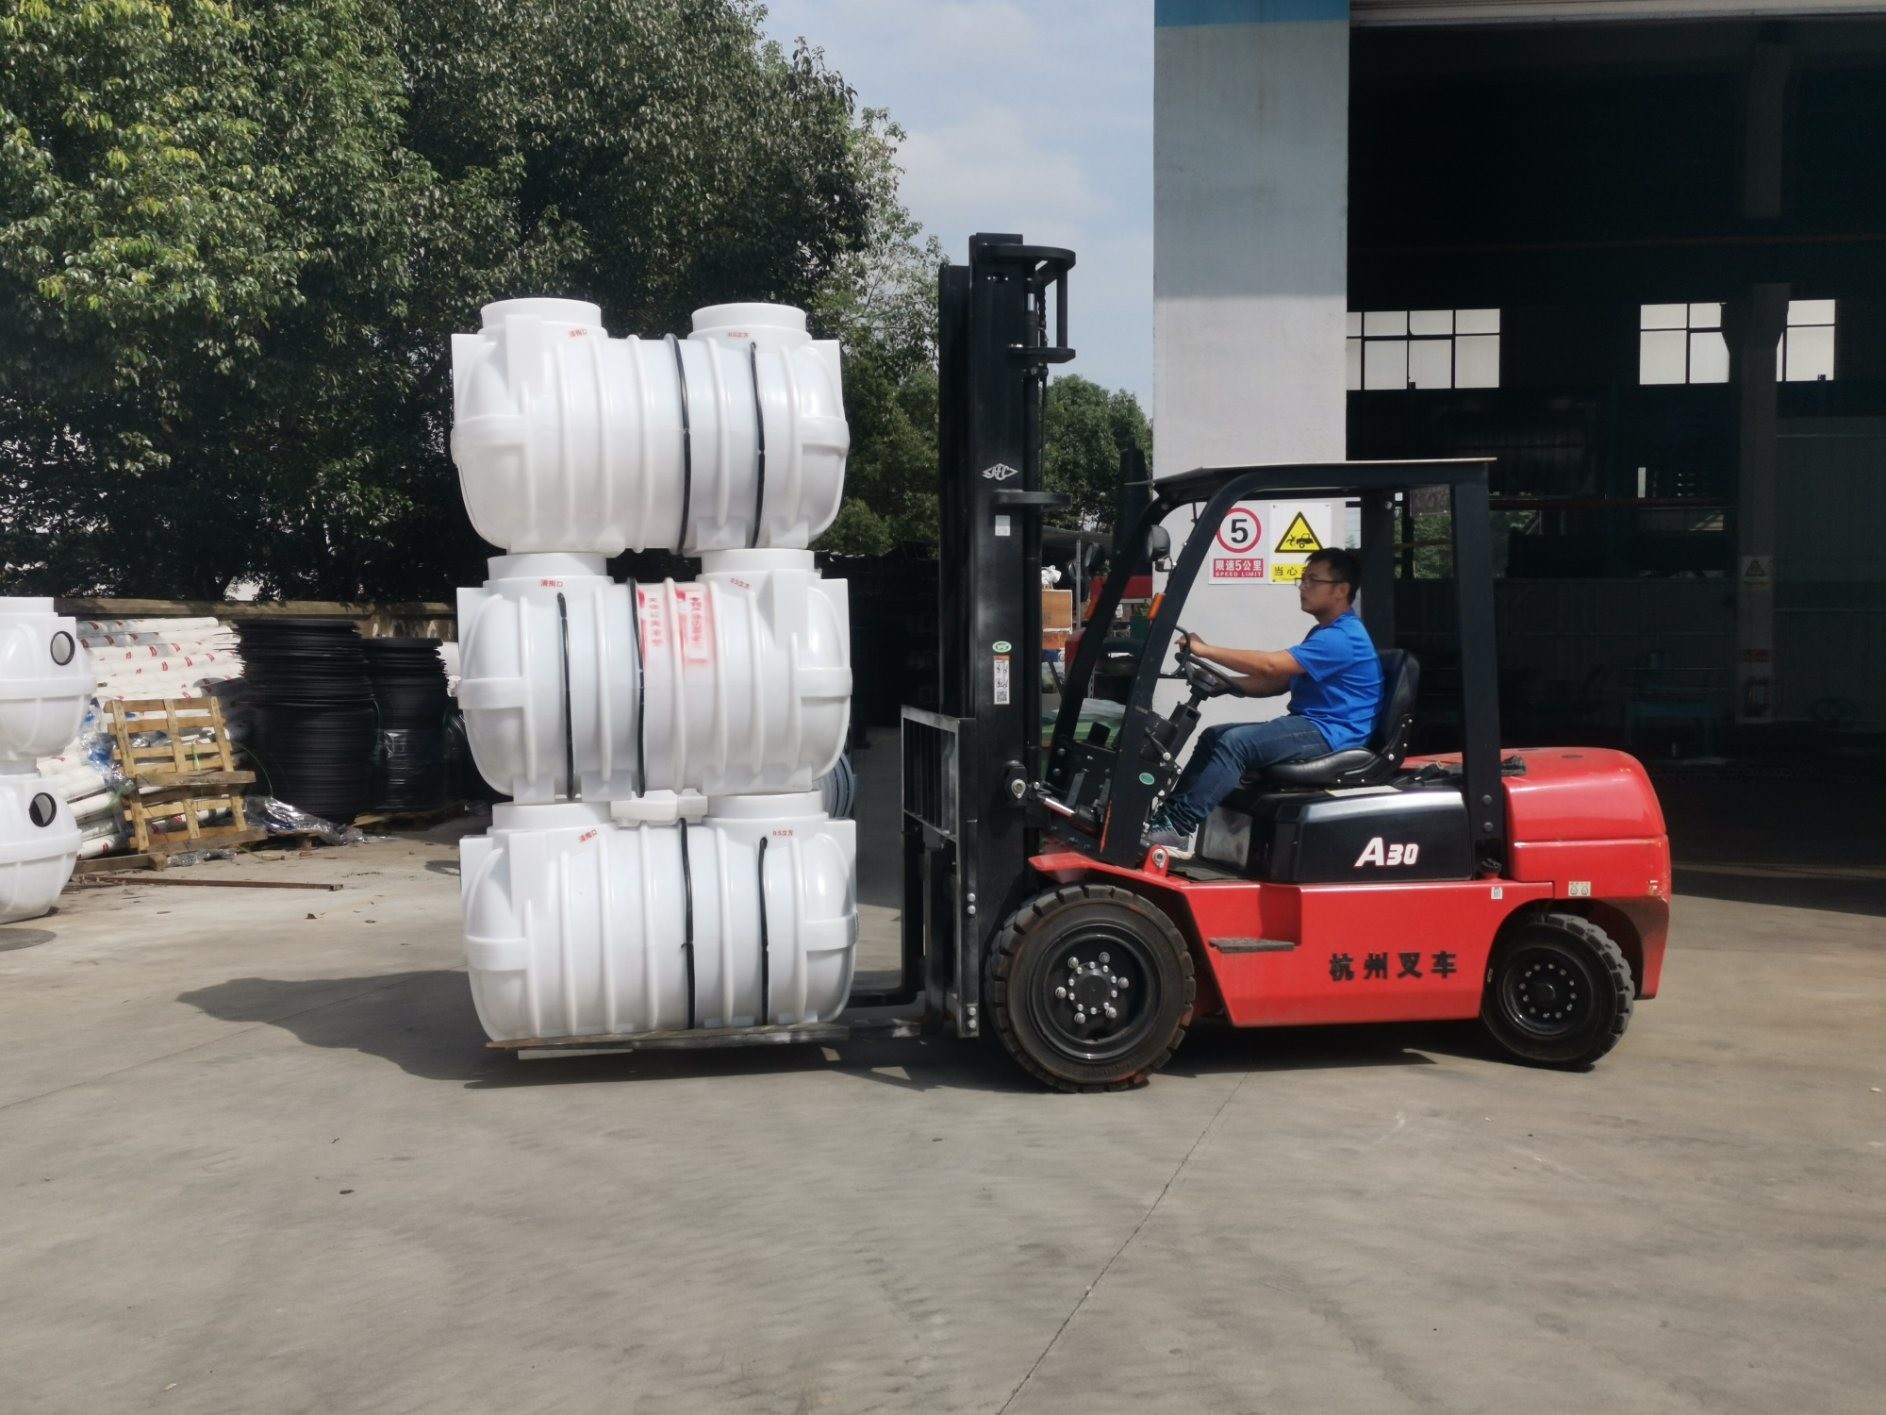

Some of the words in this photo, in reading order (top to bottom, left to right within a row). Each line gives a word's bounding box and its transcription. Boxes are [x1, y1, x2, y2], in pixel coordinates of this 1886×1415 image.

[1230, 518, 1249, 543] 5
[1215, 559, 1262, 571] 限速5公里
[1274, 566, 1307, 577] 当心
[1354, 837, 1420, 867] A30
[1329, 951, 1457, 982] 杭州叉车
